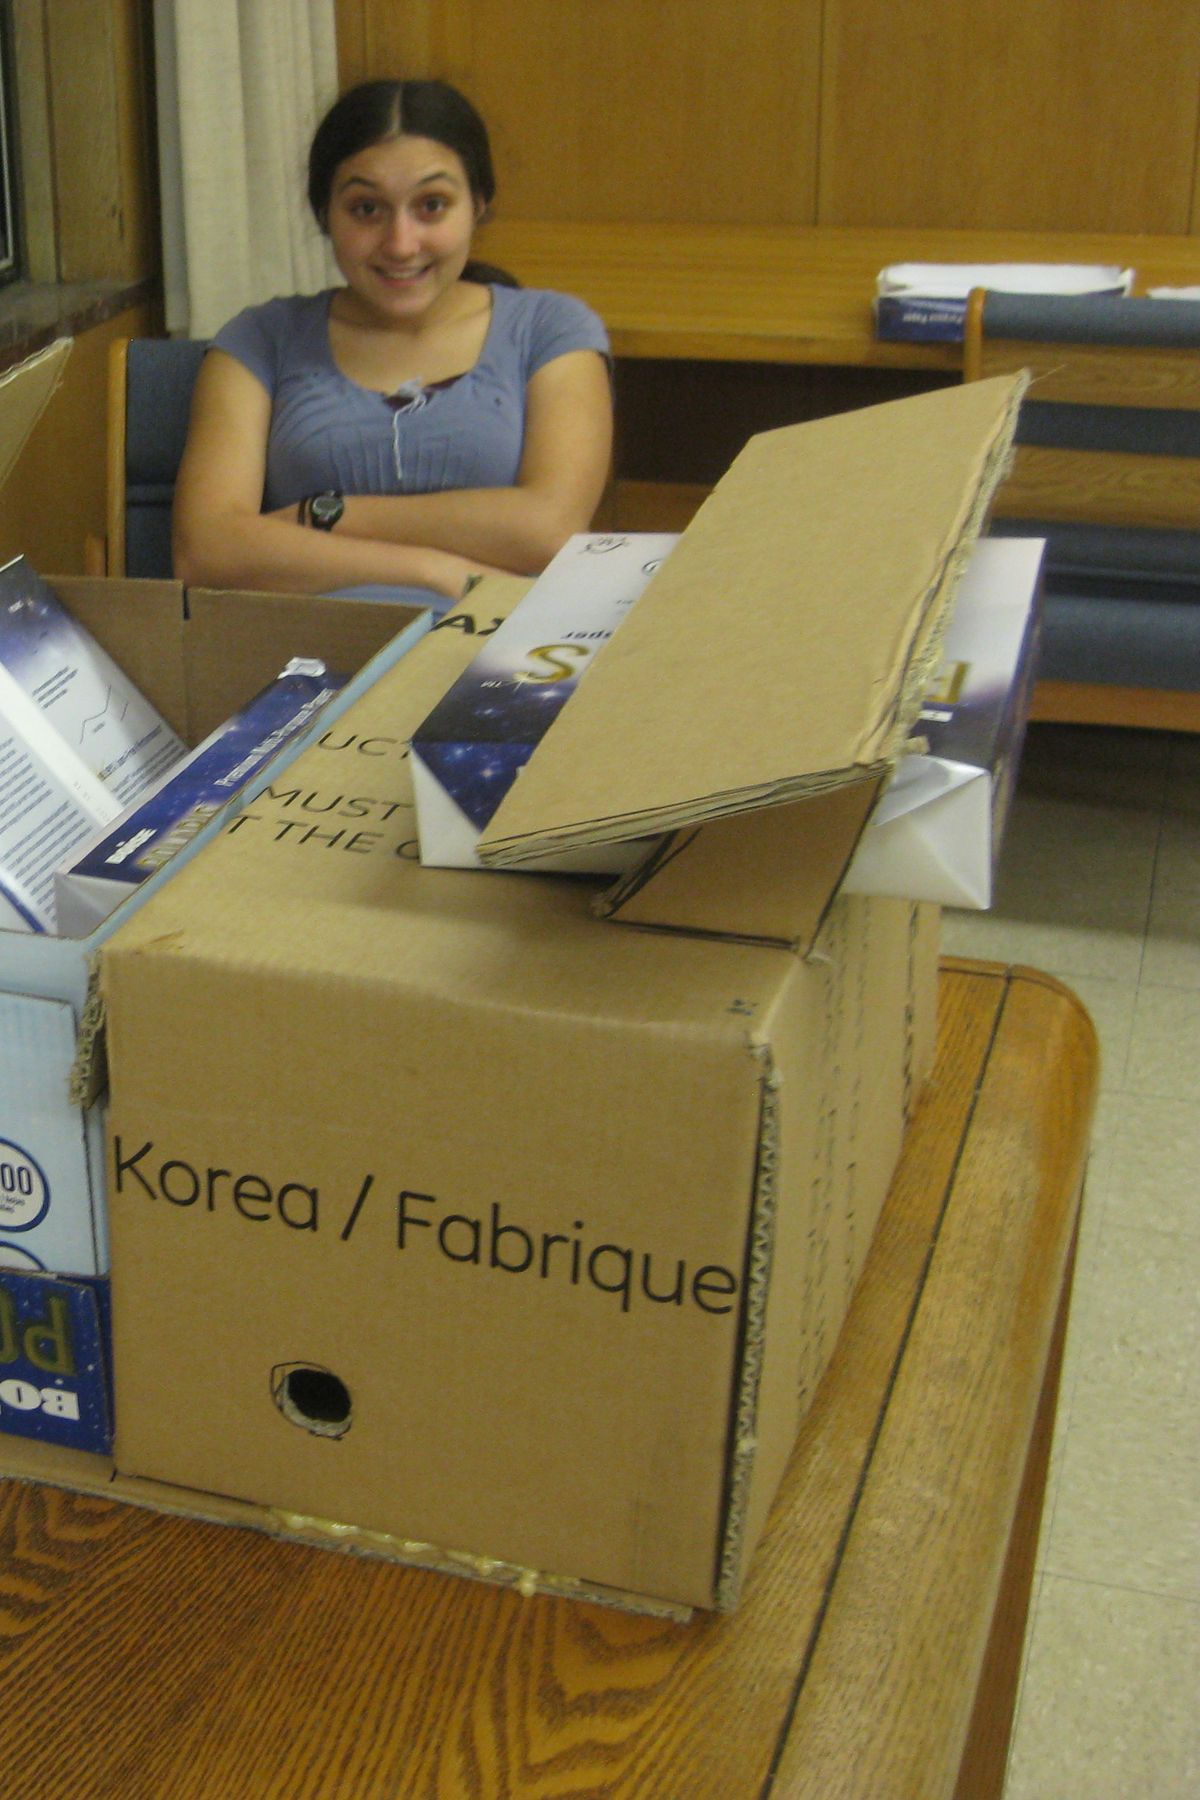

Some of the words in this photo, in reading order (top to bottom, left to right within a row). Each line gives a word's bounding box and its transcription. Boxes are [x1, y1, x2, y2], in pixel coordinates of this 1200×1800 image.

[249, 785, 415, 821] MUST
[274, 819, 385, 854] THE
[113, 1135, 320, 1233] Korea
[398, 1190, 739, 1315] Fabrique
